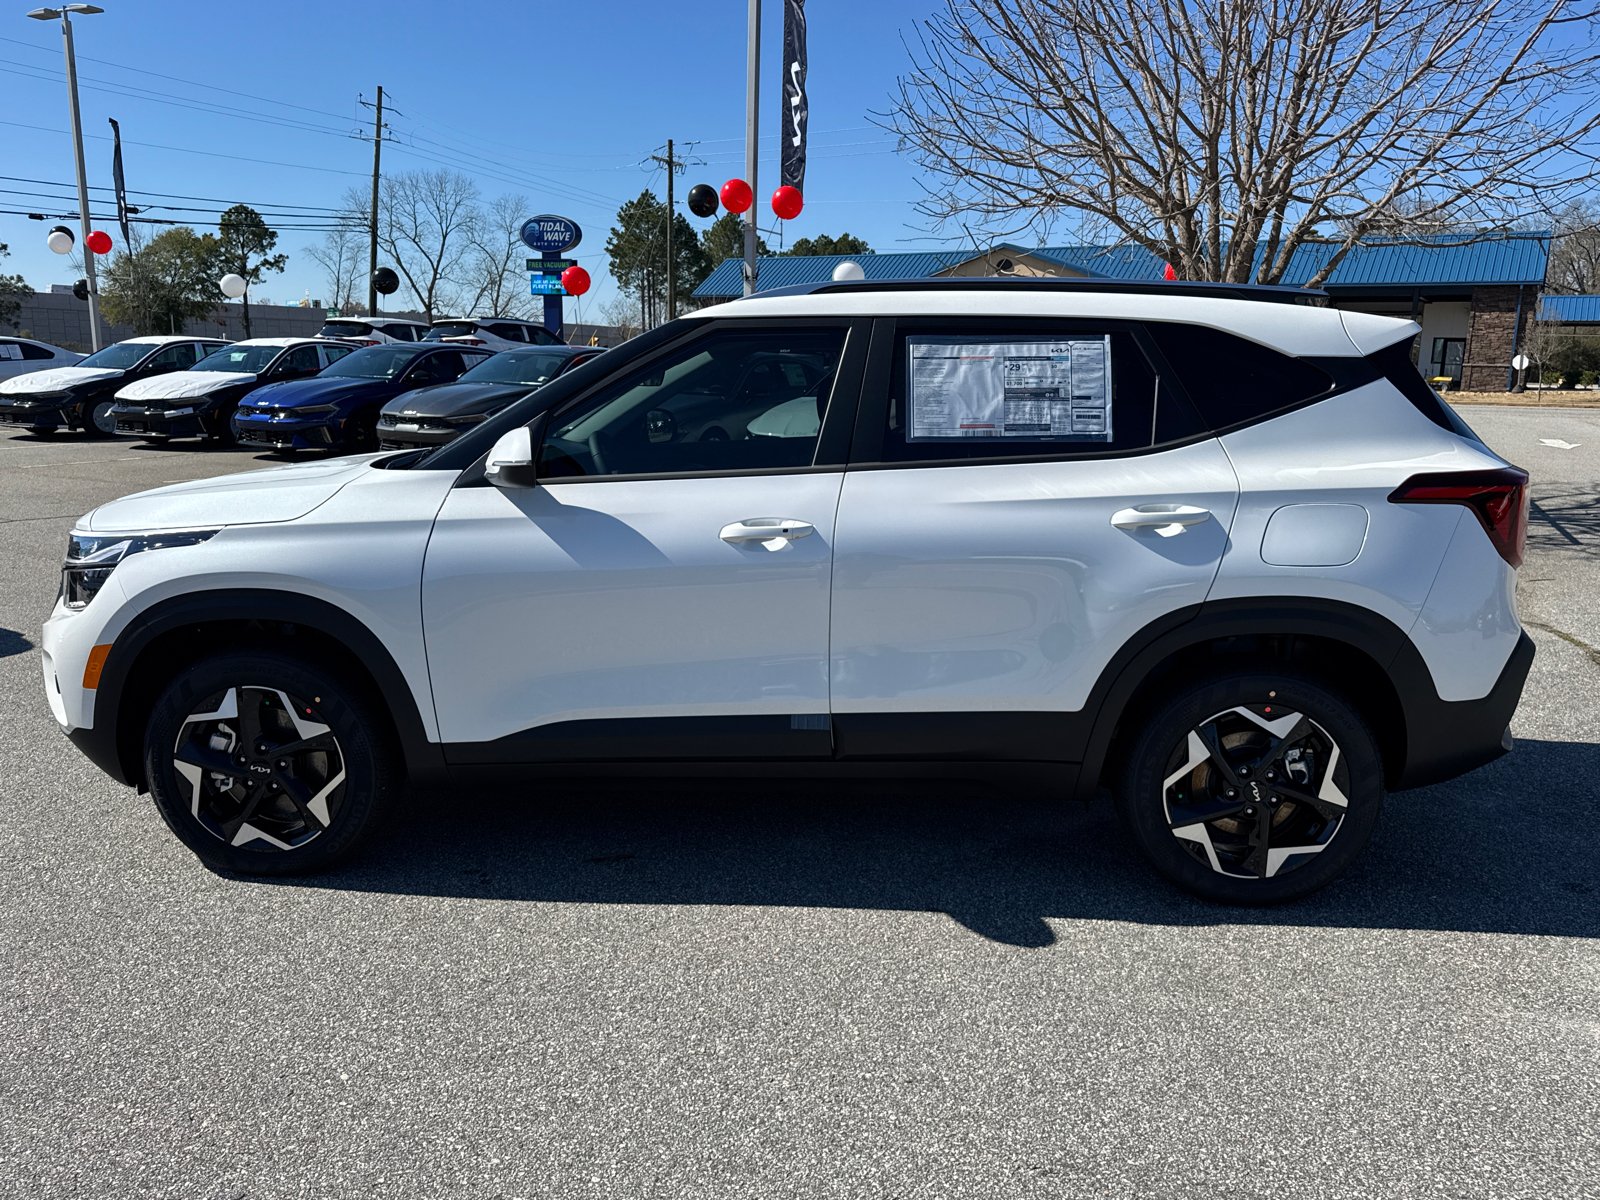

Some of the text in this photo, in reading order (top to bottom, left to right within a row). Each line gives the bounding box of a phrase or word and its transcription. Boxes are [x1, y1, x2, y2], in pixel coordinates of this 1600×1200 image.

[539, 222, 565, 231] TIDAL
[543, 232, 571, 241] WAVE
[1010, 363, 1021, 371] 29
